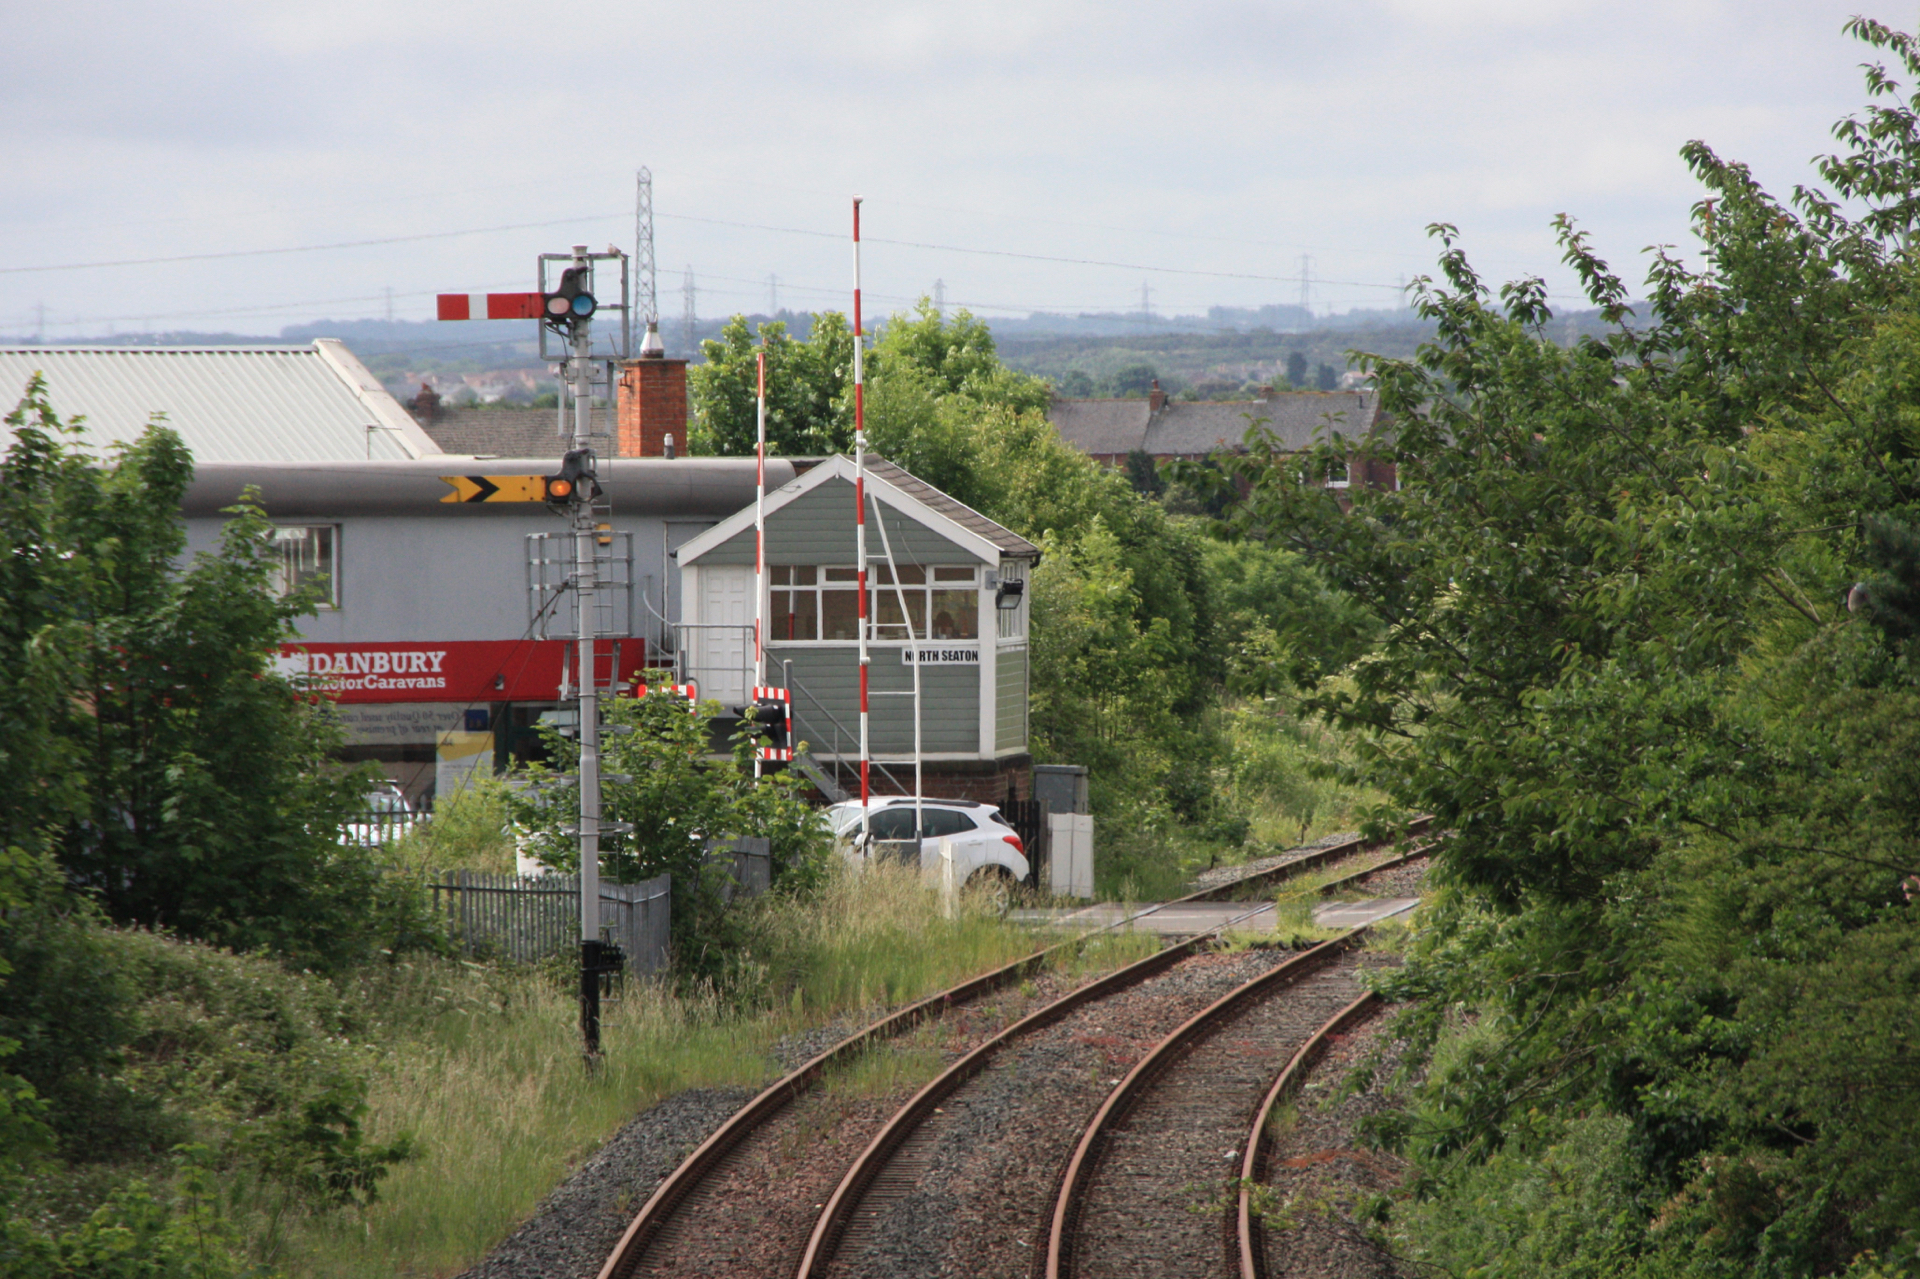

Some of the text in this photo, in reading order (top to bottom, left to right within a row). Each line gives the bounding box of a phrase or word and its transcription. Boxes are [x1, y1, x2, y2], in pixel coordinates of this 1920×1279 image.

[311, 651, 447, 674] DANBURY
[905, 649, 978, 662] NRTH SEATON
